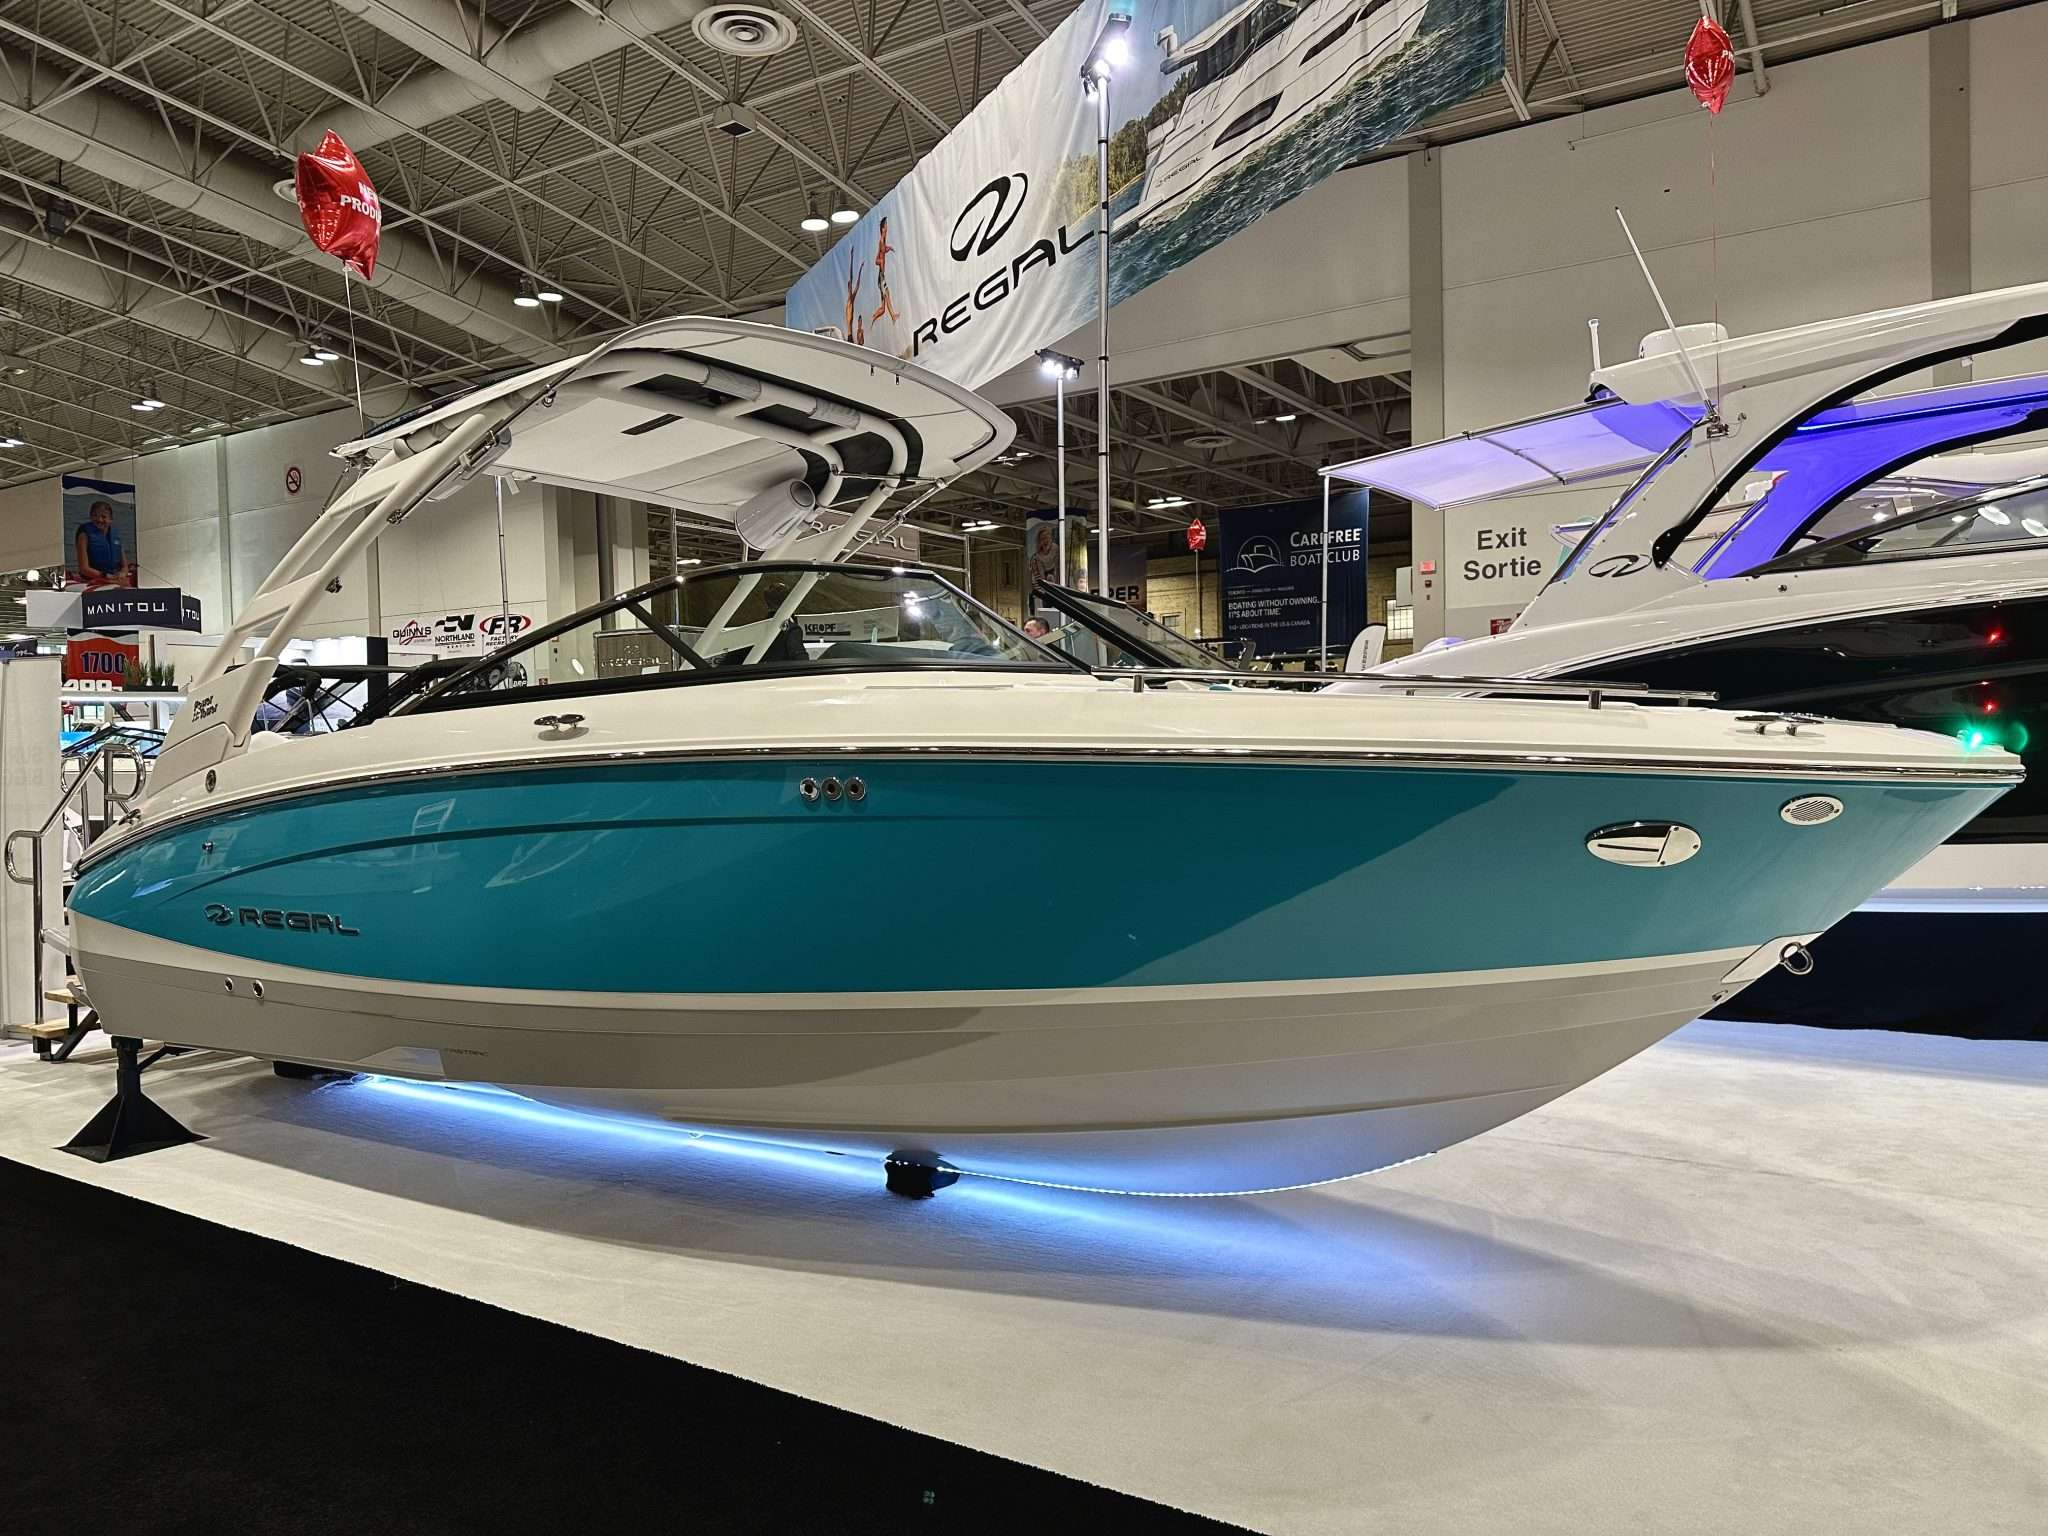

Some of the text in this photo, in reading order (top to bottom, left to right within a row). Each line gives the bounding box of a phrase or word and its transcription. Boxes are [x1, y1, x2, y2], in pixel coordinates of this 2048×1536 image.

[913, 225, 1095, 357] REGAL
[811, 520, 918, 551] RGAL
[1477, 527, 1528, 551] Exit
[1290, 549, 1361, 567] BOAT CLUB
[1463, 556, 1542, 581] Sortie
[87, 602, 165, 616] MANITOU
[1228, 600, 1257, 610] BOATING
[1258, 598, 1288, 608] WITHOUT
[1241, 608, 1263, 618] ABOUT
[434, 632, 475, 643] NORTHLAND
[81, 650, 127, 674] 1700
[238, 907, 360, 936] REGAL
